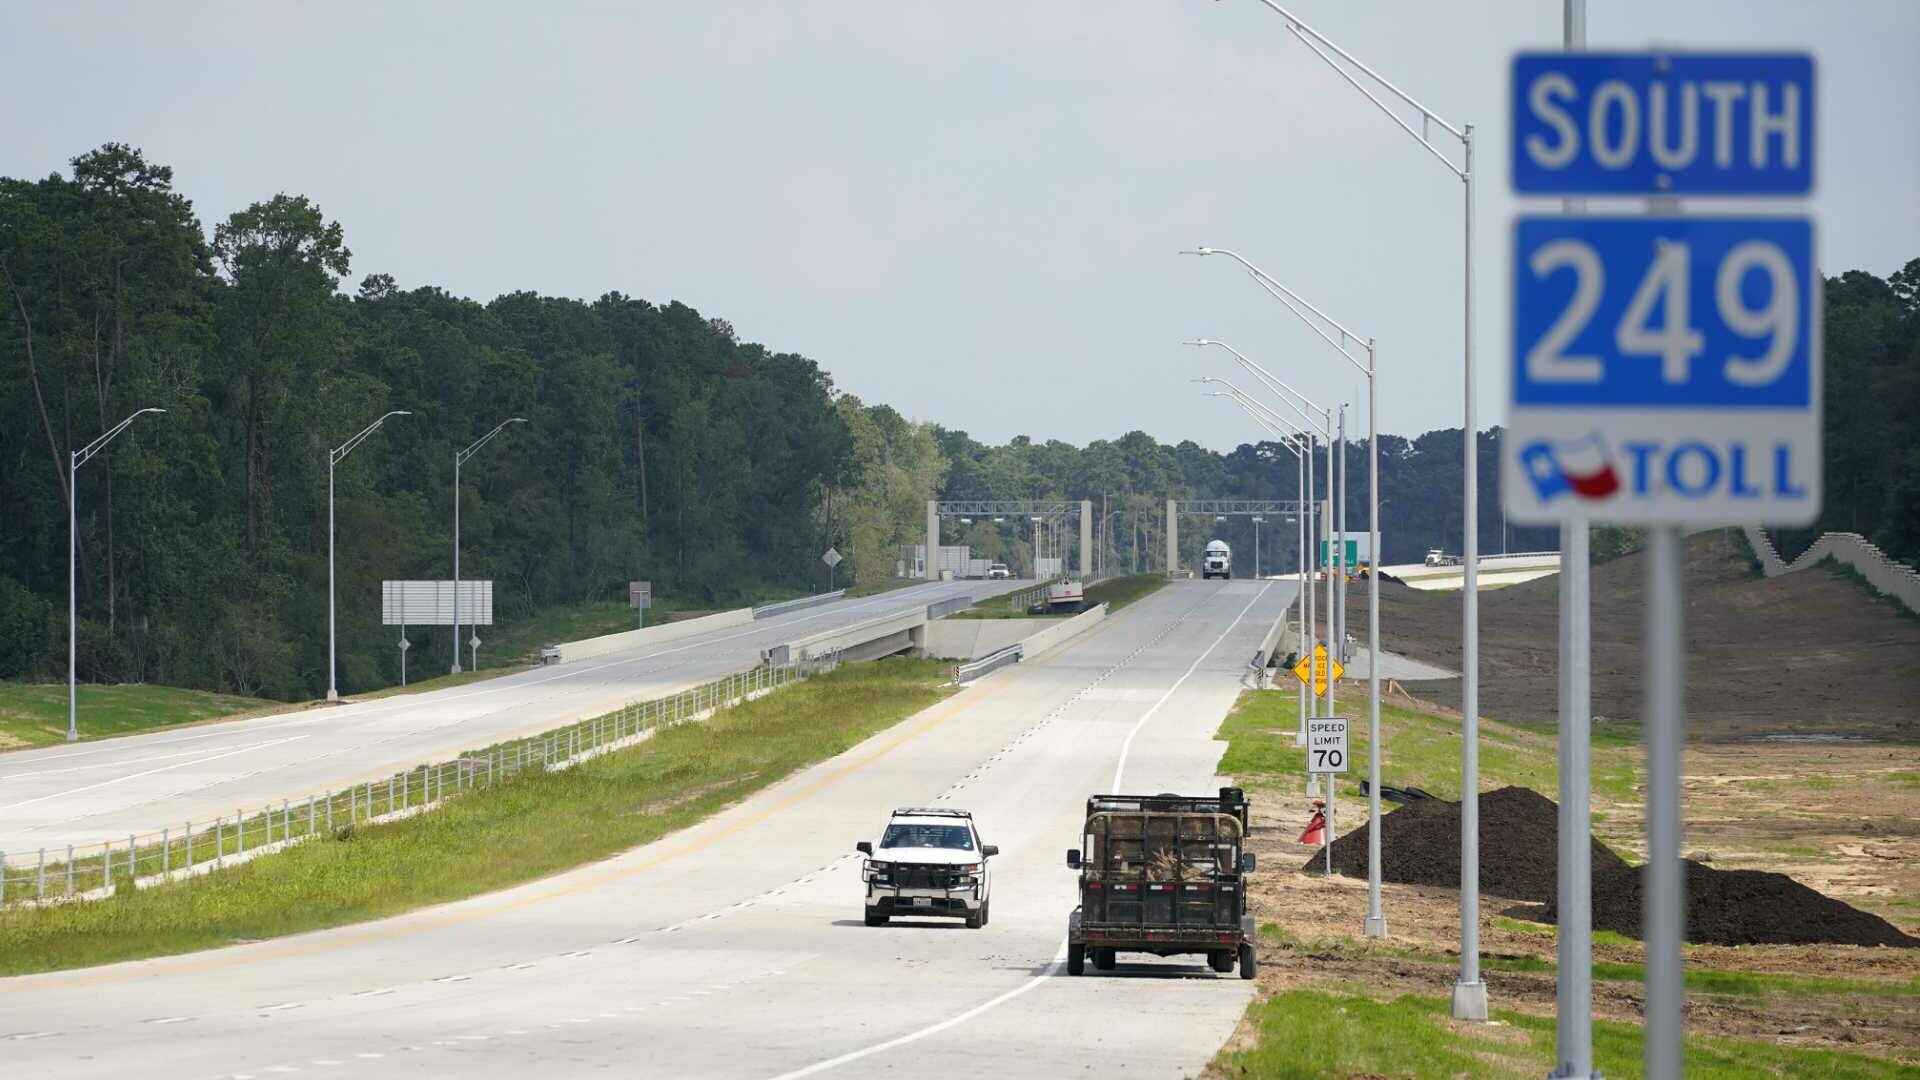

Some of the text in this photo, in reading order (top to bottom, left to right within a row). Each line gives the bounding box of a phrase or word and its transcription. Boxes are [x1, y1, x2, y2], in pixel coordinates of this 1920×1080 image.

[1525, 72, 1800, 169] SOUTH
[1525, 239, 1800, 386] 249
[1623, 441, 1807, 498] TOLL
[1311, 723, 1345, 732] SPEED
[1314, 736, 1341, 745] LIMIT
[1313, 750, 1342, 767] 70
